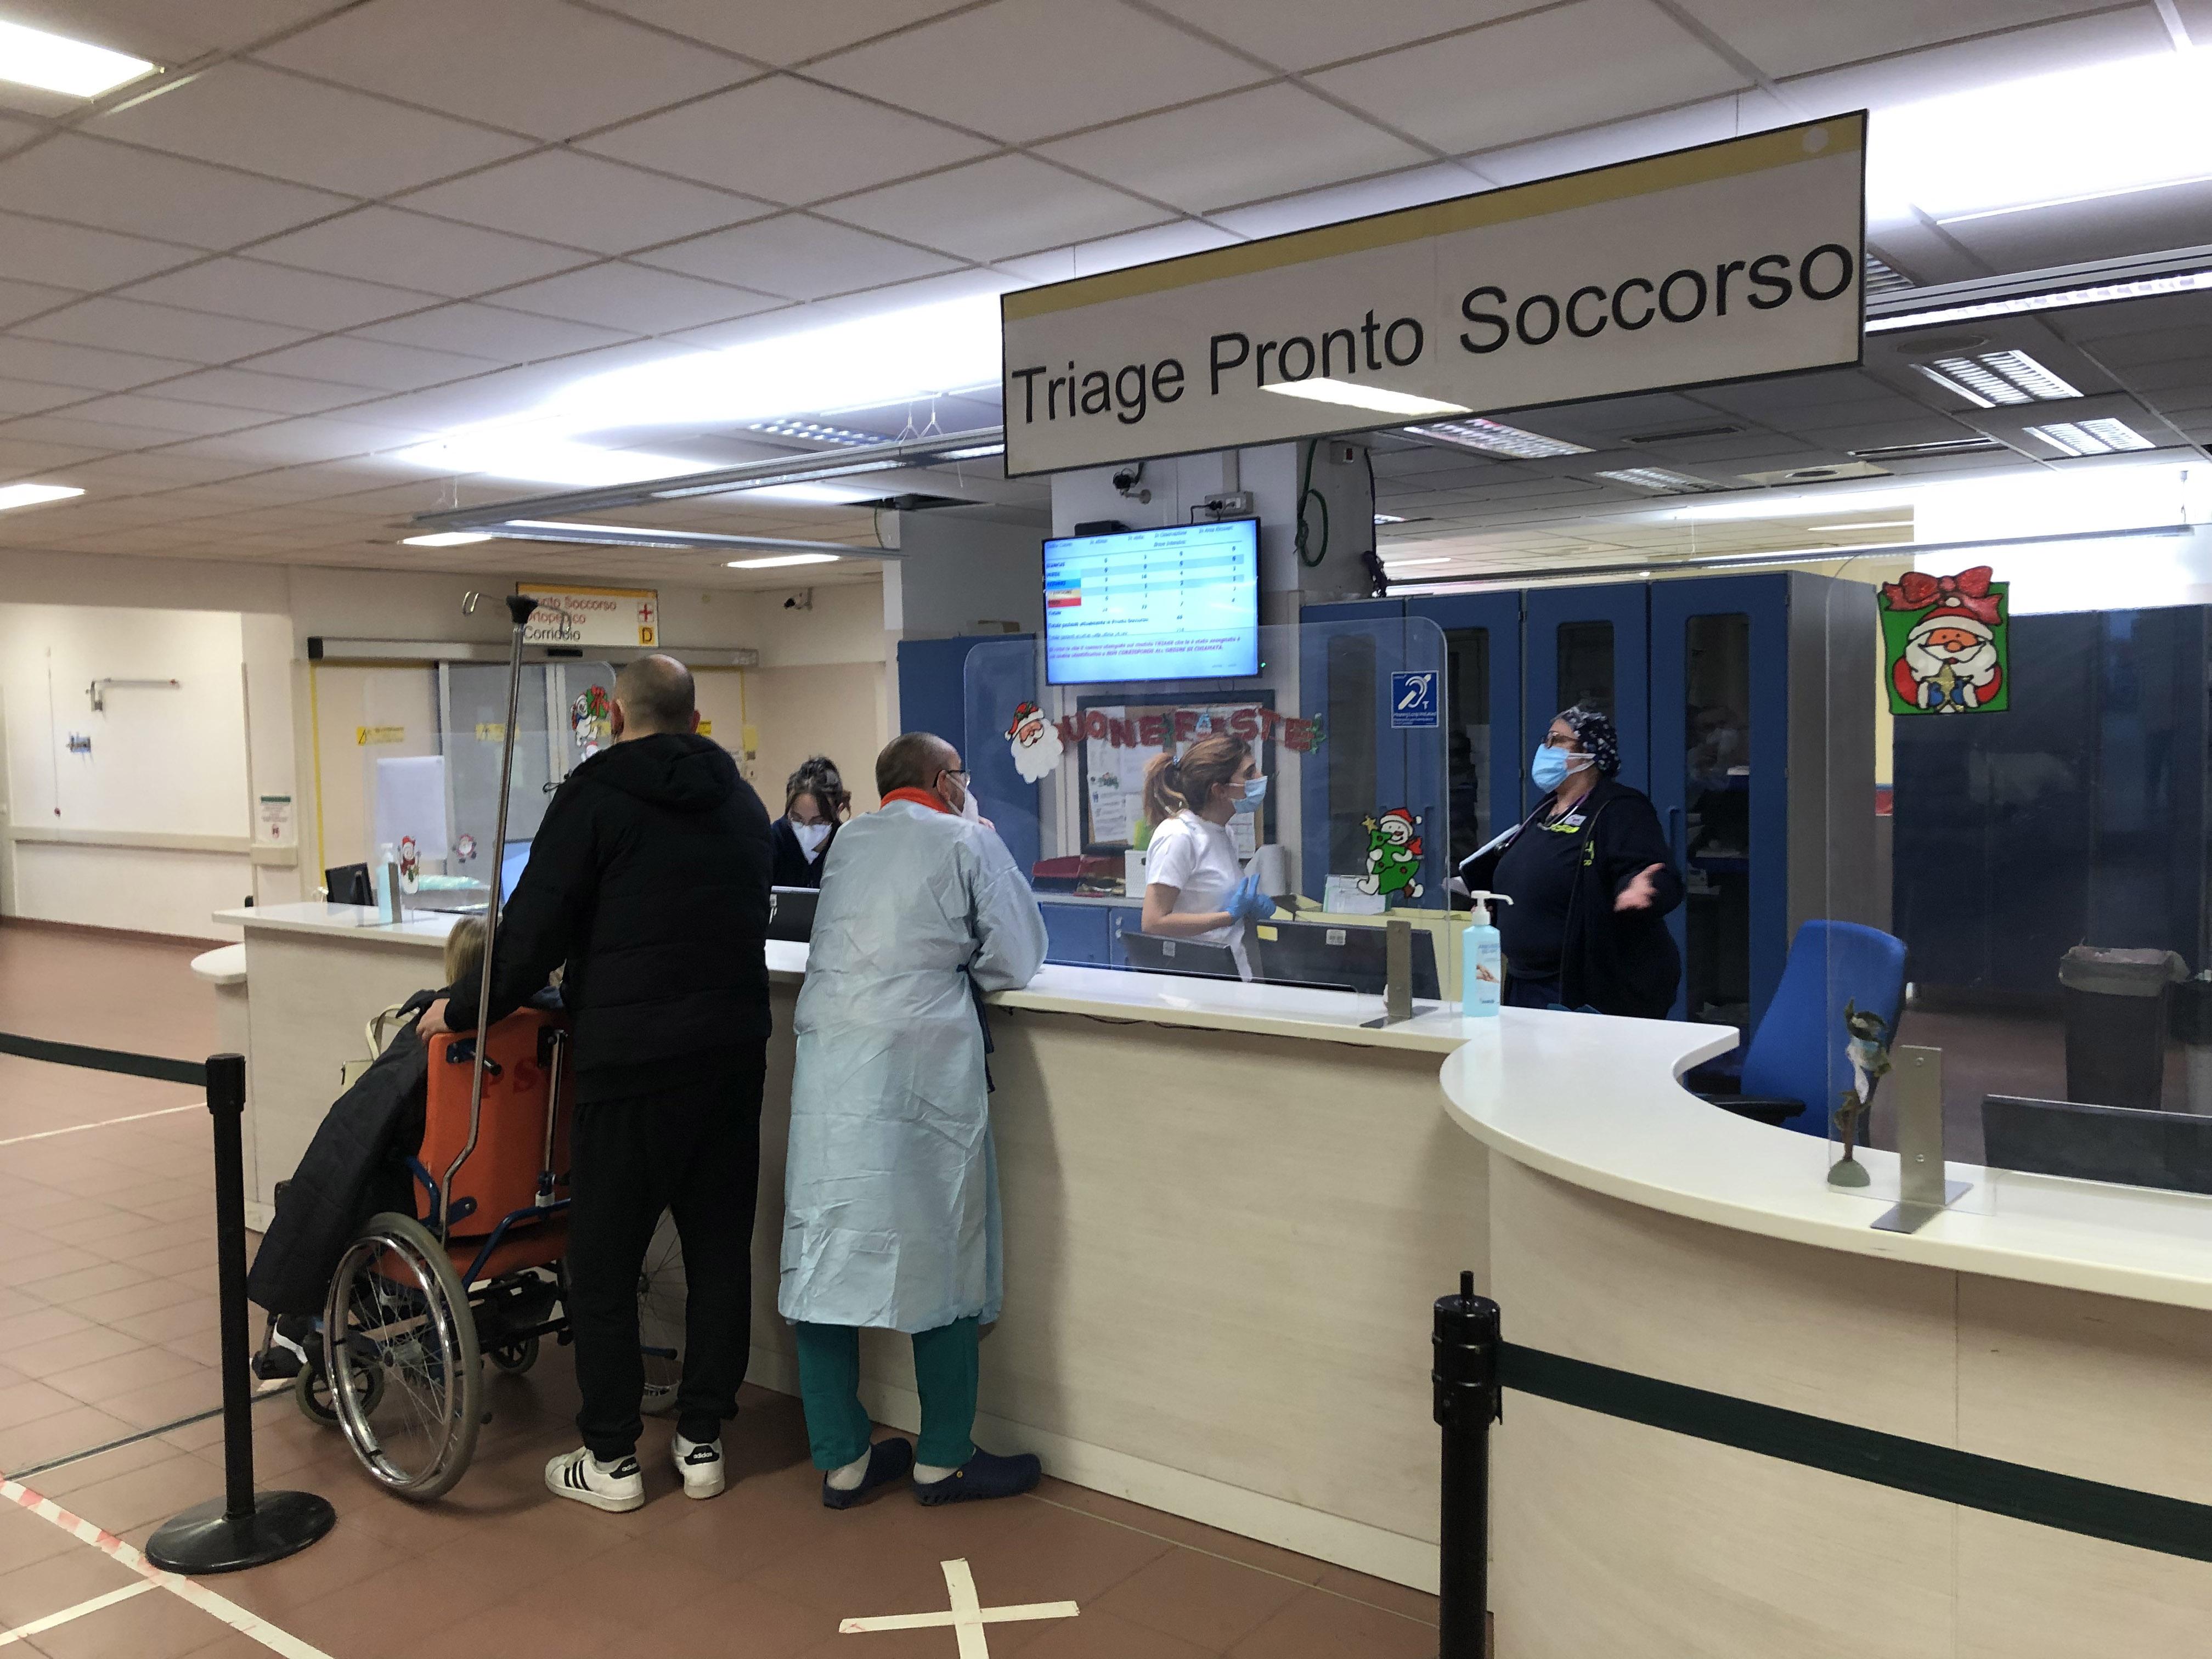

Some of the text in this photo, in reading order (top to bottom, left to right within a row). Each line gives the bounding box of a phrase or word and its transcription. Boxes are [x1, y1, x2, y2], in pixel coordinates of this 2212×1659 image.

[1012, 242, 1854, 425] Triage Pronto Soccorso
[564, 596, 616, 612] Soccorso
[642, 627, 652, 644] D
[1053, 709, 1170, 749] UONE
